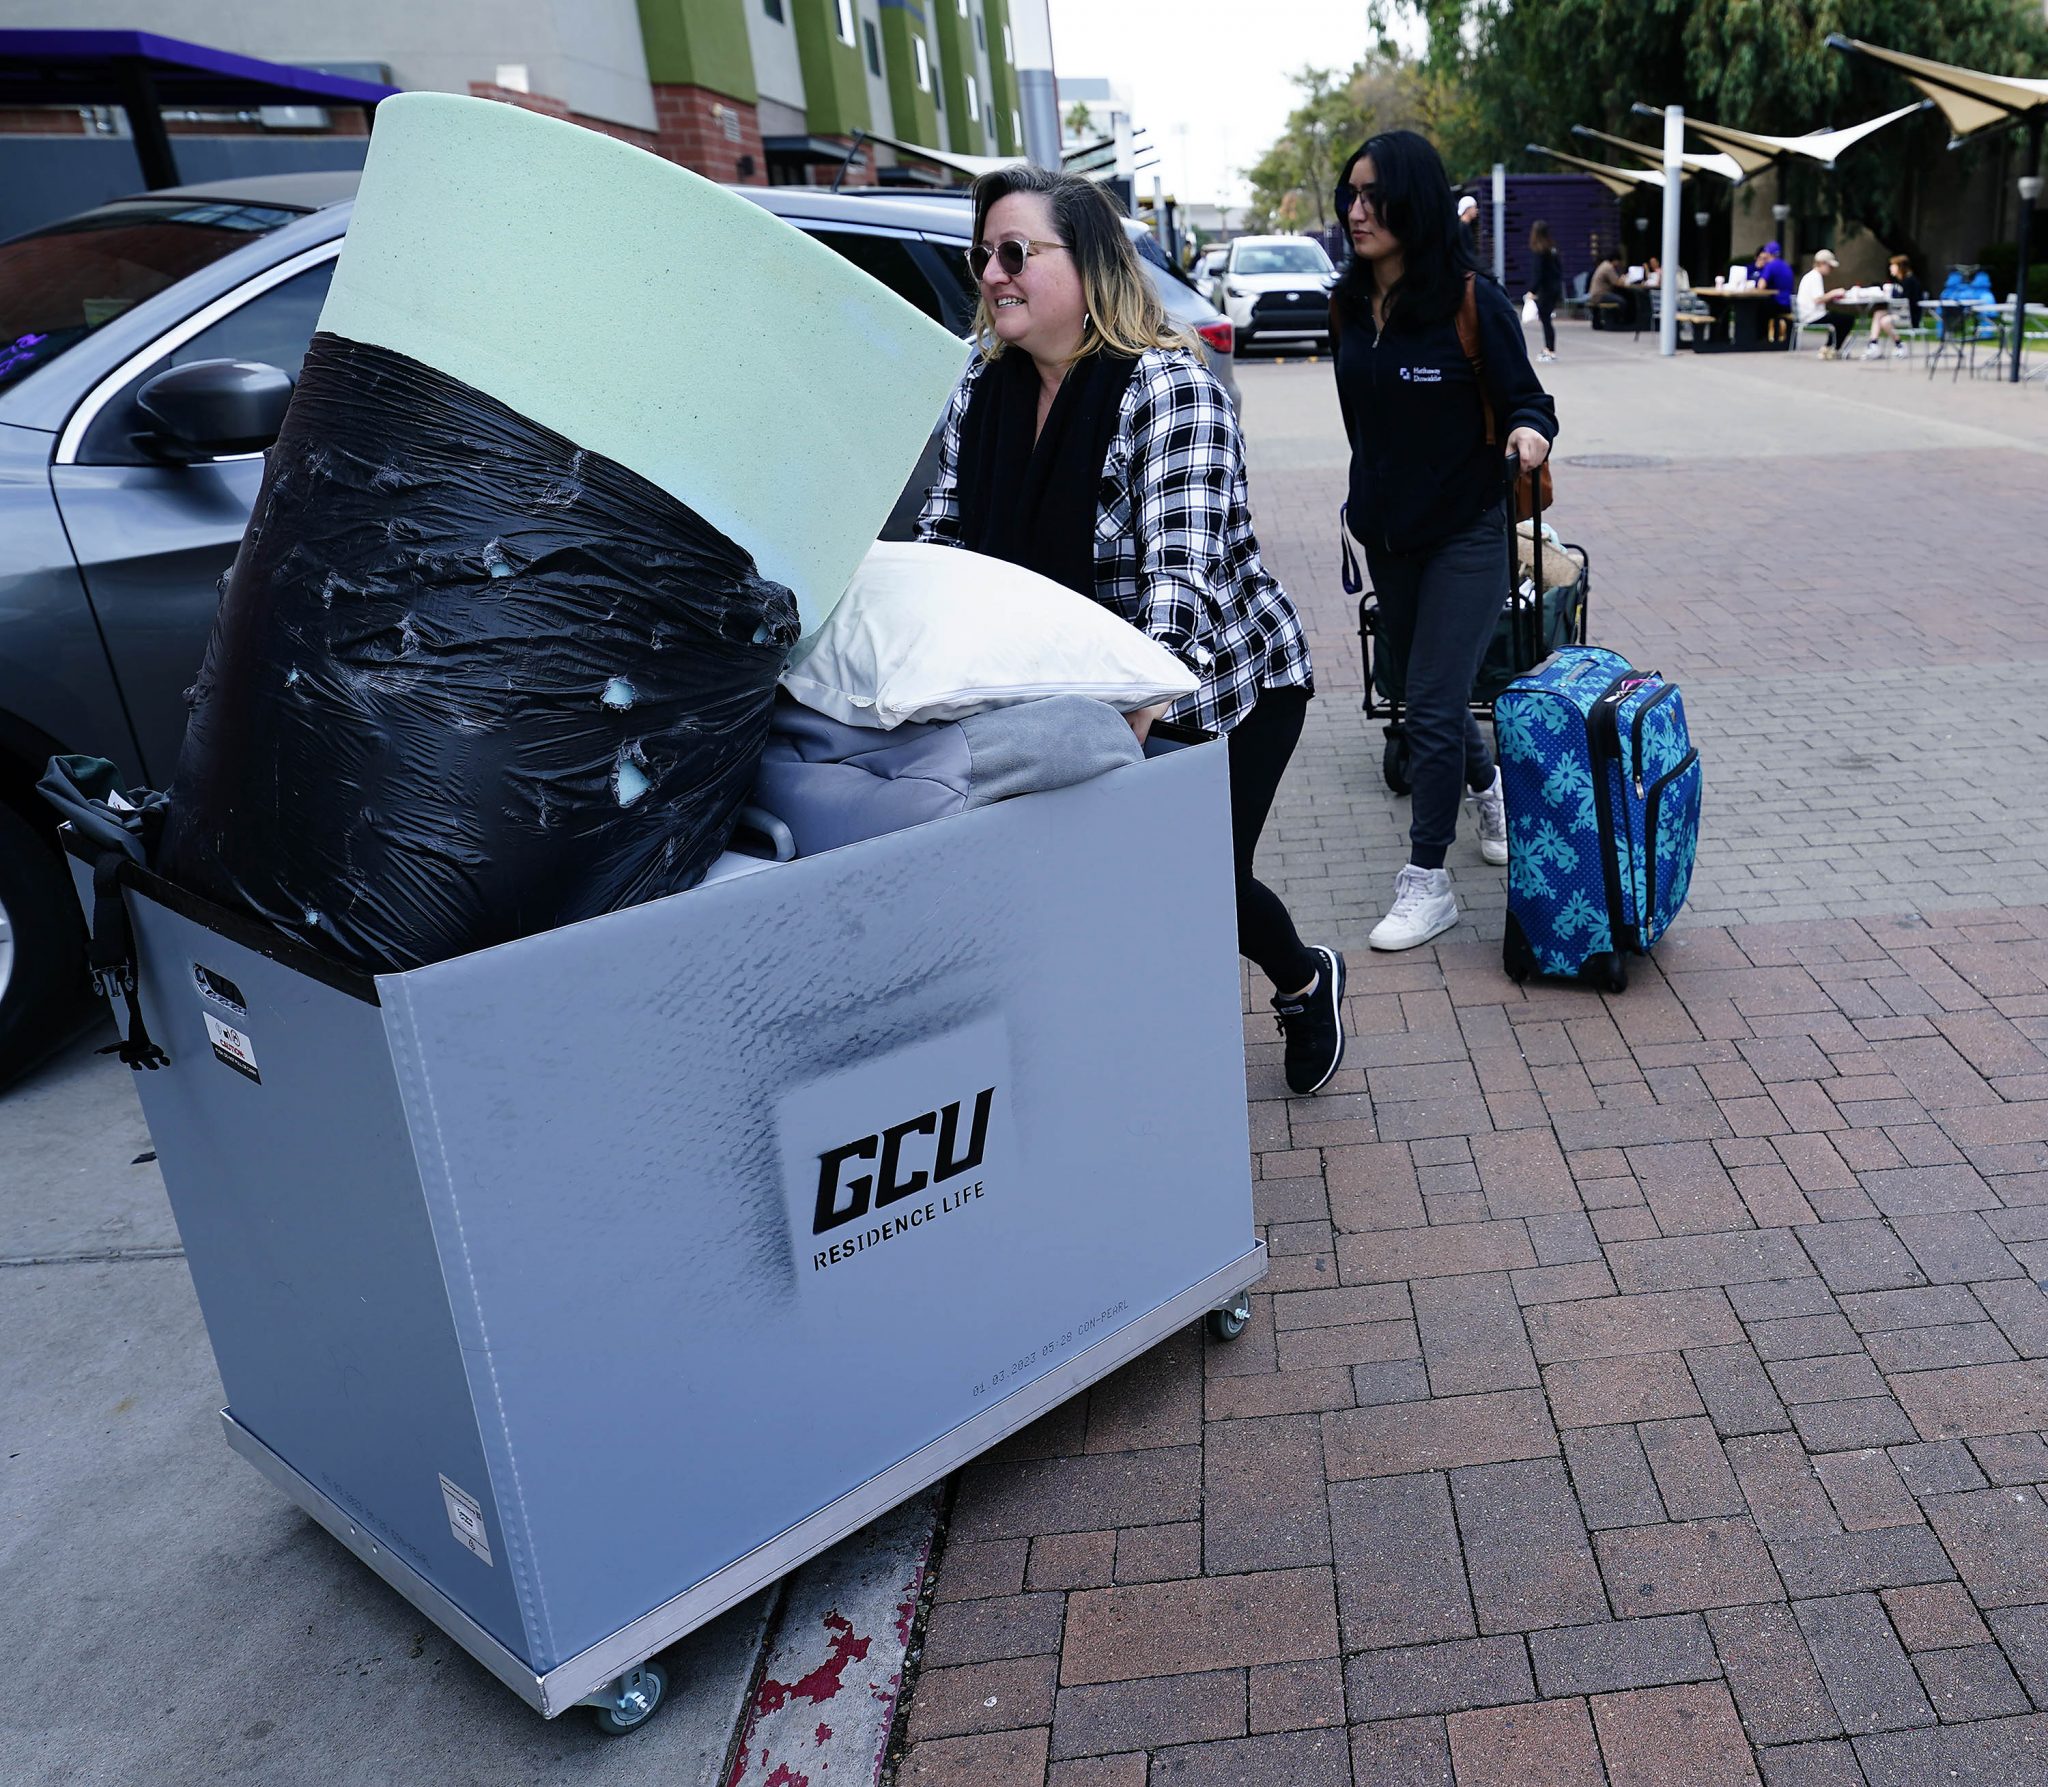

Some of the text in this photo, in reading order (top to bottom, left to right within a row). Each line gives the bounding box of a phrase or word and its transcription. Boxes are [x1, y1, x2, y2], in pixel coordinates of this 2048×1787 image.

[813, 1086, 996, 1235] GCU
[813, 1181, 985, 1271] RESIDENCE LIFE
